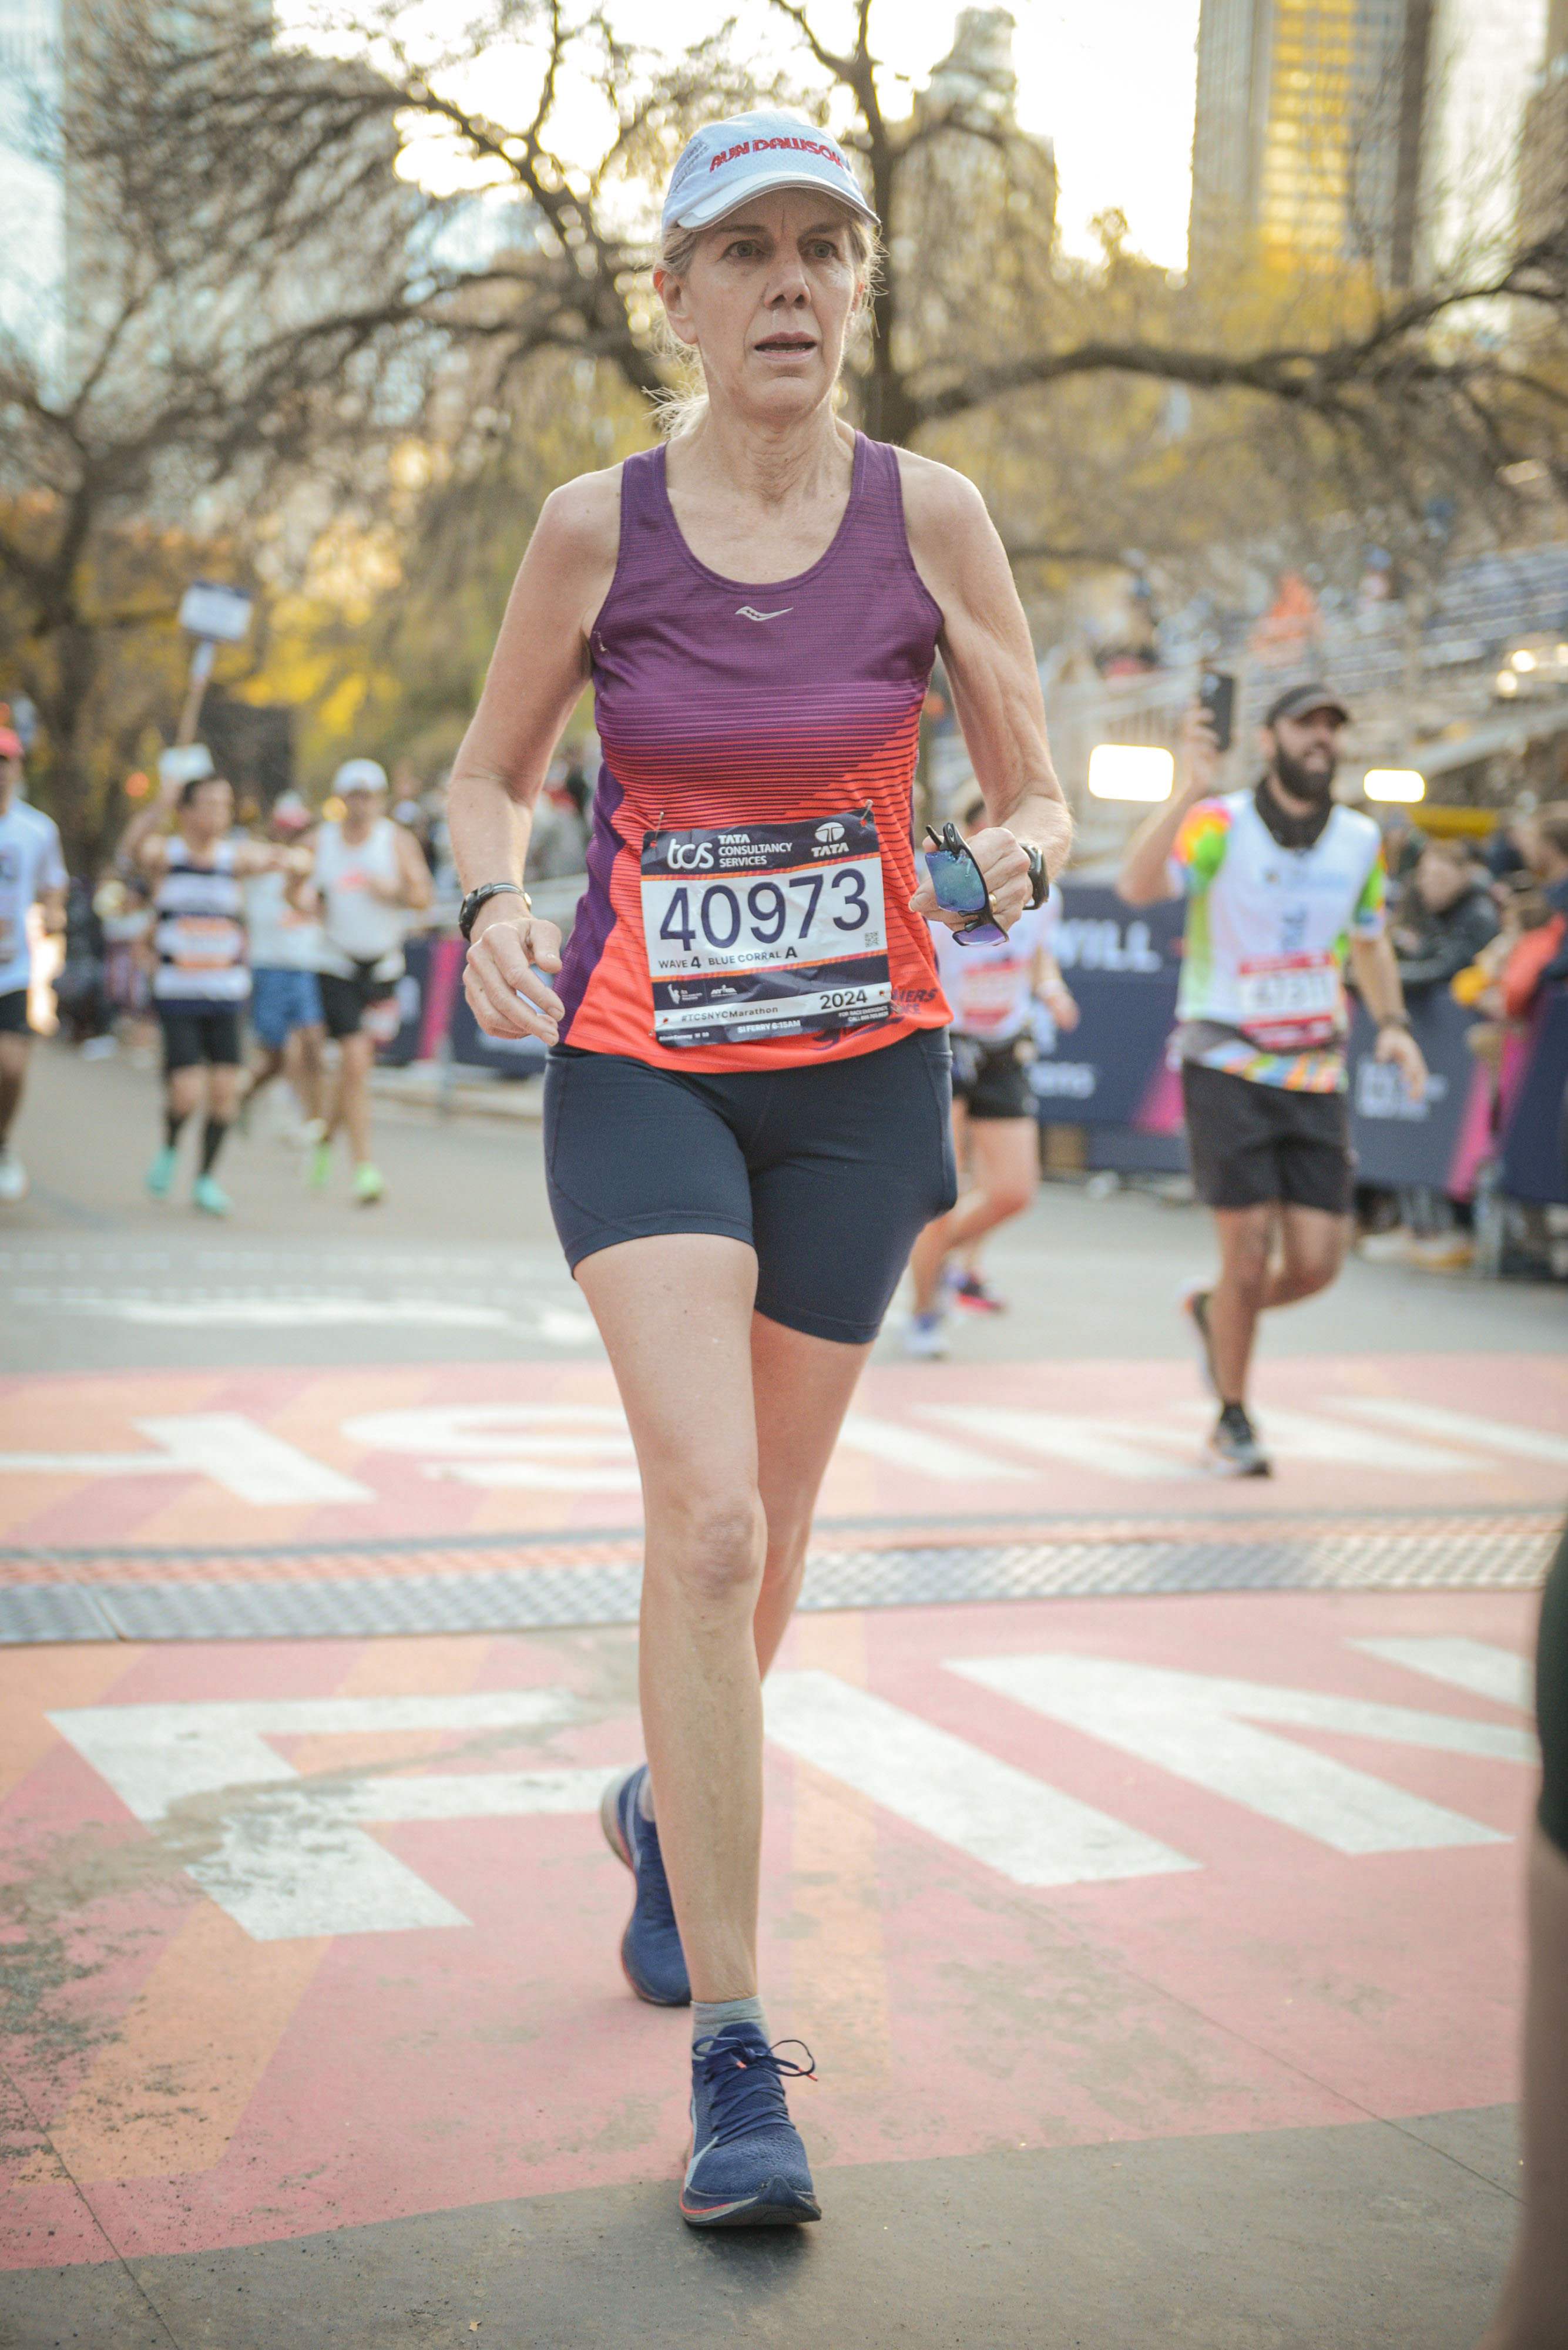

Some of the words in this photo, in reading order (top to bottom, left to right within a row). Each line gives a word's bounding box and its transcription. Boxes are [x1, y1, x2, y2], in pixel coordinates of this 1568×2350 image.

[718, 834, 750, 844] TATA
[667, 838, 714, 870] tcs
[718, 842, 793, 856] CONSULTANCY
[811, 842, 850, 857] TATA
[719, 855, 767, 868] SERVICES
[660, 868, 869, 951] 40973
[658, 959, 689, 969] WAVE
[691, 956, 701, 969] 4
[708, 955, 736, 965] BLUE
[738, 951, 781, 963] CORRAL
[785, 946, 798, 959] A
[820, 989, 868, 1010] 2024
[681, 1005, 778, 1022] #TCSNYCMarathon
